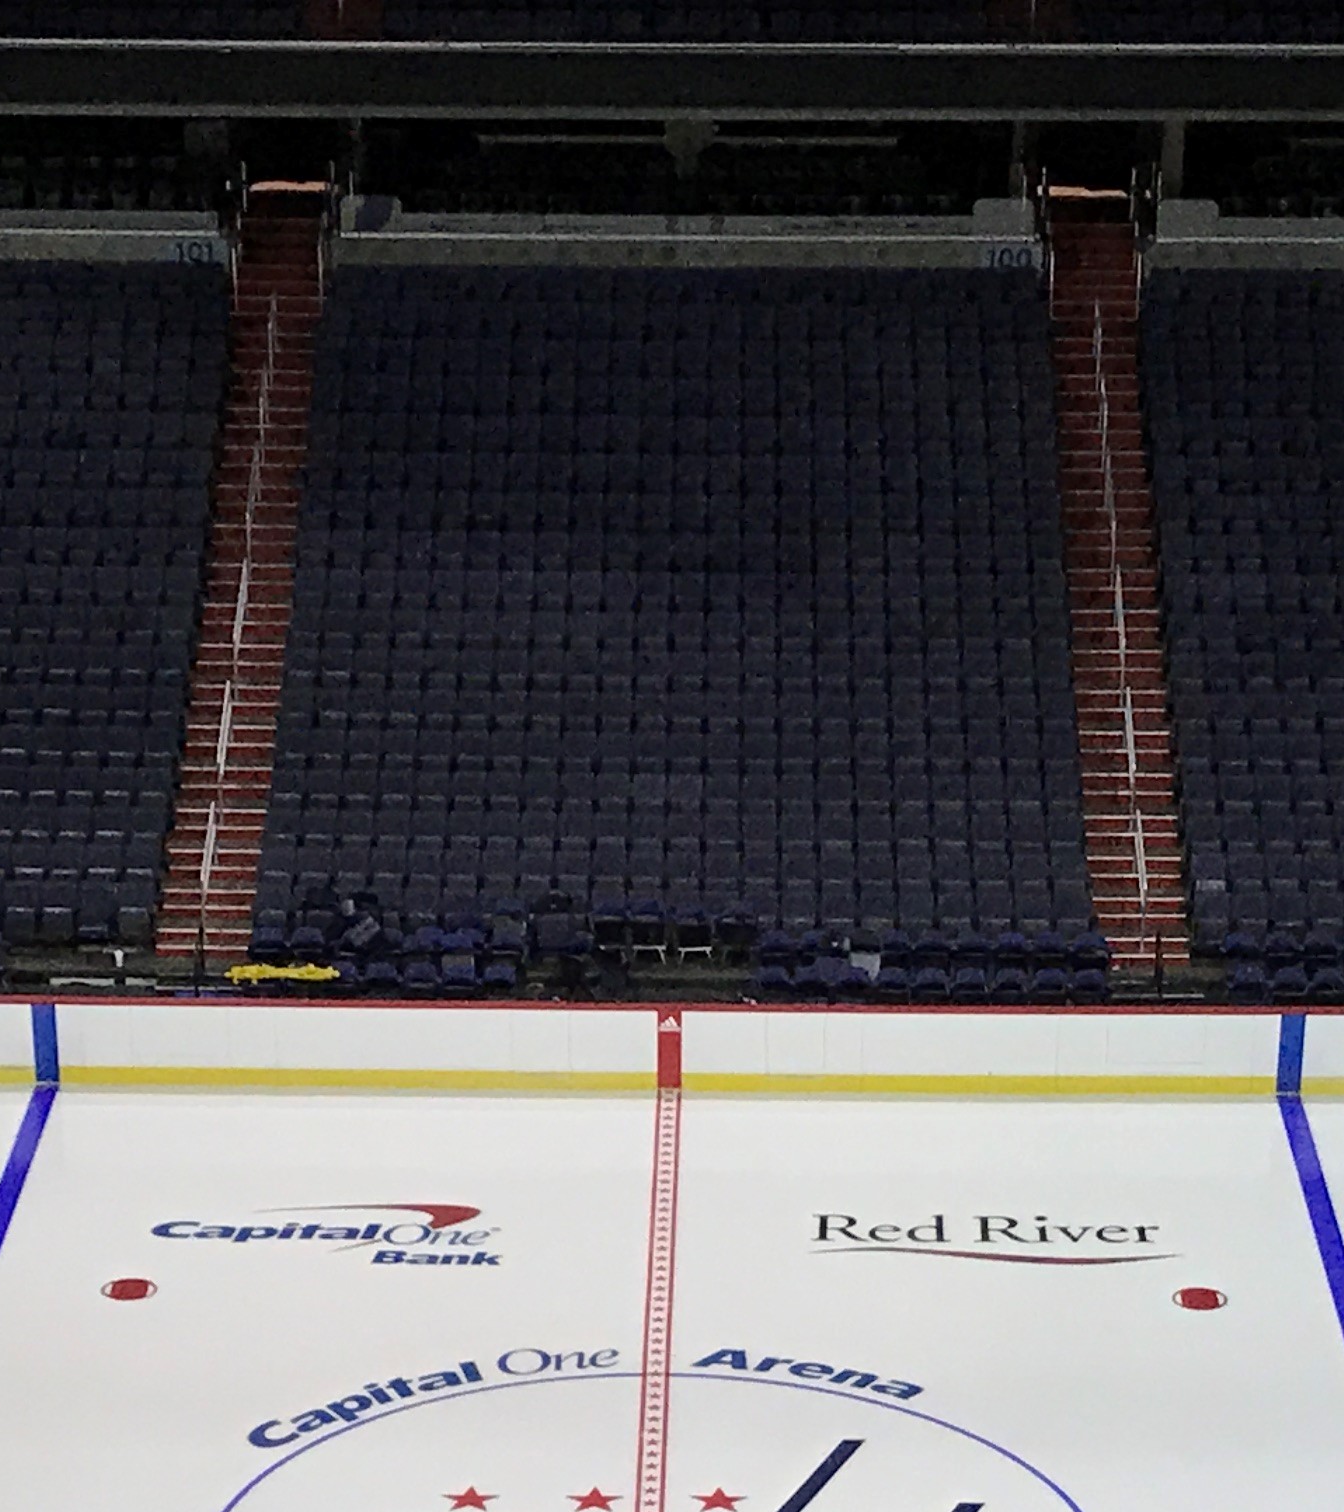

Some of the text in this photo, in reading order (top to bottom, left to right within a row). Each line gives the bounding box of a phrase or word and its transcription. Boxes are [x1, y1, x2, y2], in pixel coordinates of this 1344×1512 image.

[175, 241, 213, 263] 101
[986, 247, 1032, 268] 100
[812, 1215, 1159, 1244] Red River
[371, 1250, 503, 1266] Bank
[247, 1347, 924, 1449] Capital One Arena
